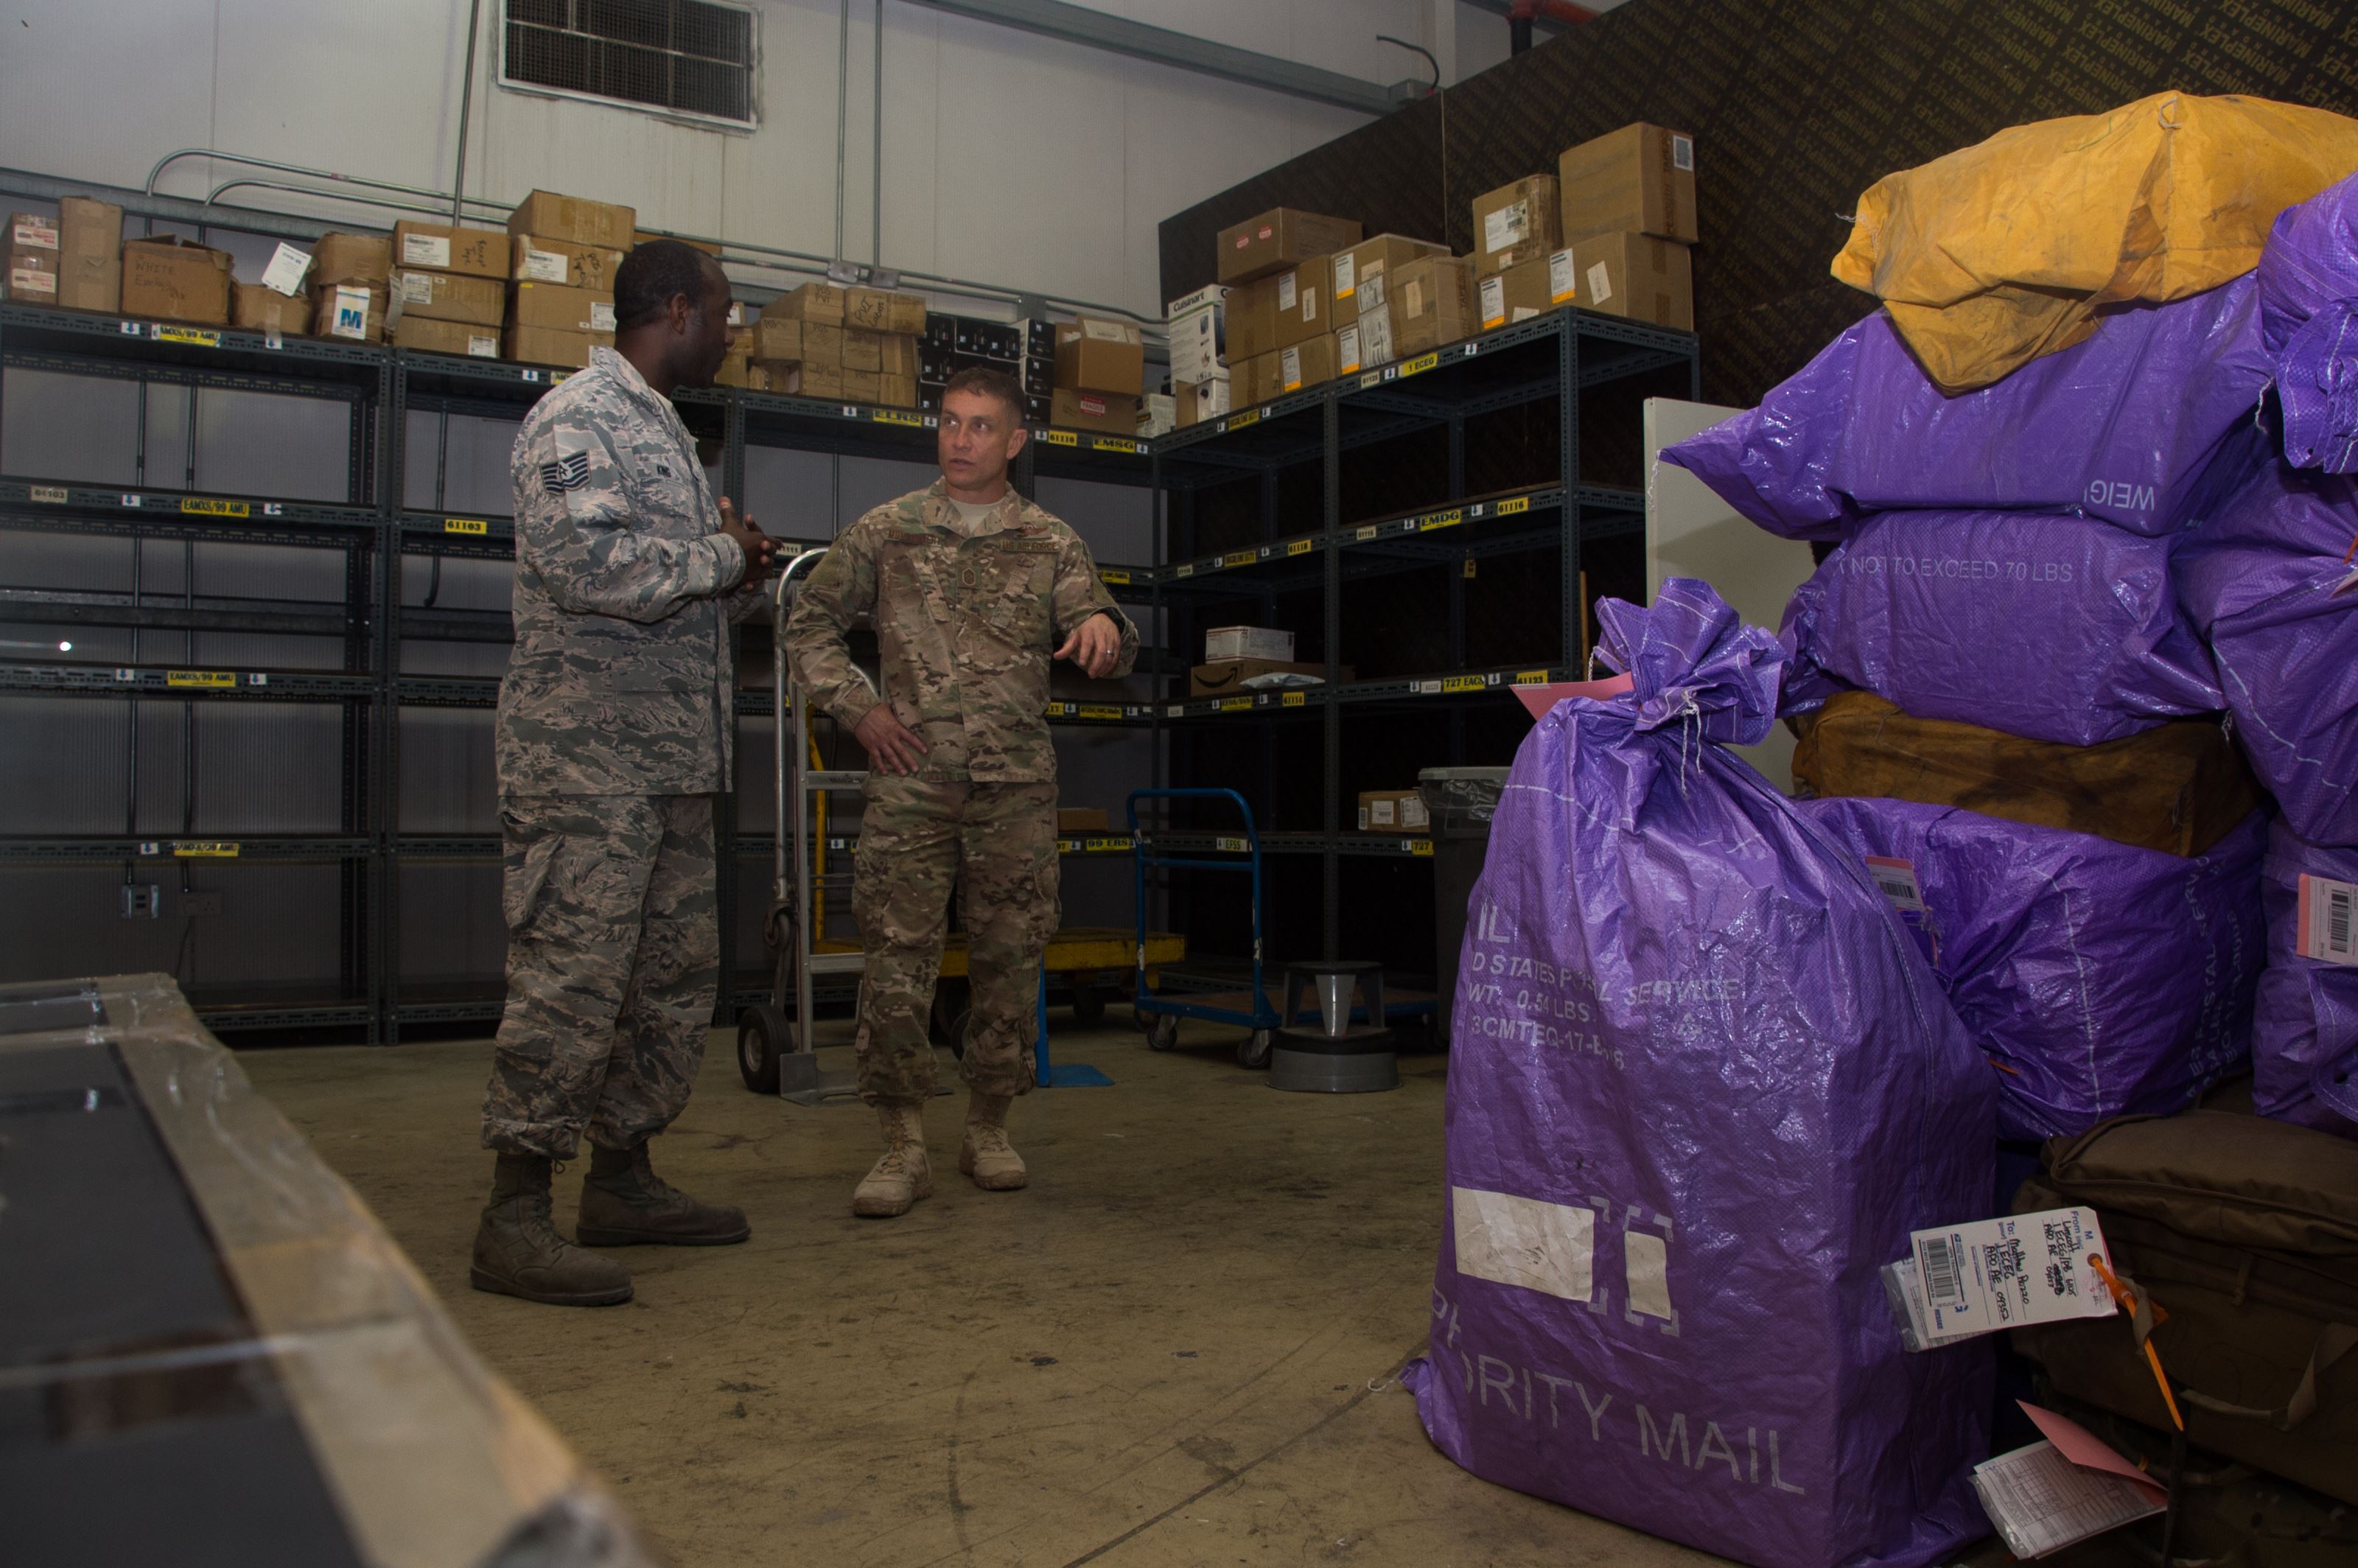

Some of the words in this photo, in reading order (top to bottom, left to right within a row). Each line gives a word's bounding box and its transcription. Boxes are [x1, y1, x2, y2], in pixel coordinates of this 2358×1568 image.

[2078, 20, 2161, 78] MARINEPLEX
[2199, 24, 2291, 85] MARINEPLEX
[1174, 292, 1204, 312] Cuisinart
[1415, 358, 1434, 370] ECEG
[2083, 479, 2155, 512] WEIG
[230, 502, 247, 514] AMU
[1499, 501, 1524, 513] 61116
[447, 522, 482, 531] 61103
[1421, 511, 1459, 525] EMDG
[1002, 541, 1014, 550] US
[1018, 542, 1029, 550] AIR
[1032, 542, 1057, 551] FORCE
[1851, 556, 1887, 575] NOT
[1893, 557, 1914, 575] TO
[1921, 559, 1999, 579] EXCEED
[2006, 561, 2026, 581] 70
[2032, 562, 2073, 582] LBS
[1446, 679, 1460, 687] 727
[1412, 841, 1430, 852] 727
[1489, 955, 1556, 985] STATES
[2007, 1221, 2015, 1235] To:
[2071, 1211, 2080, 1233] From
[2043, 1224, 2054, 1239] APO
[2049, 1245, 2058, 1256] AE
[2085, 1231, 2093, 1239] M
[1986, 1246, 1998, 1266] APO
[2000, 1252, 2015, 1279] ECEG
[1991, 1270, 2001, 1284] AE
[1636, 1404, 1805, 1496] MAIL
